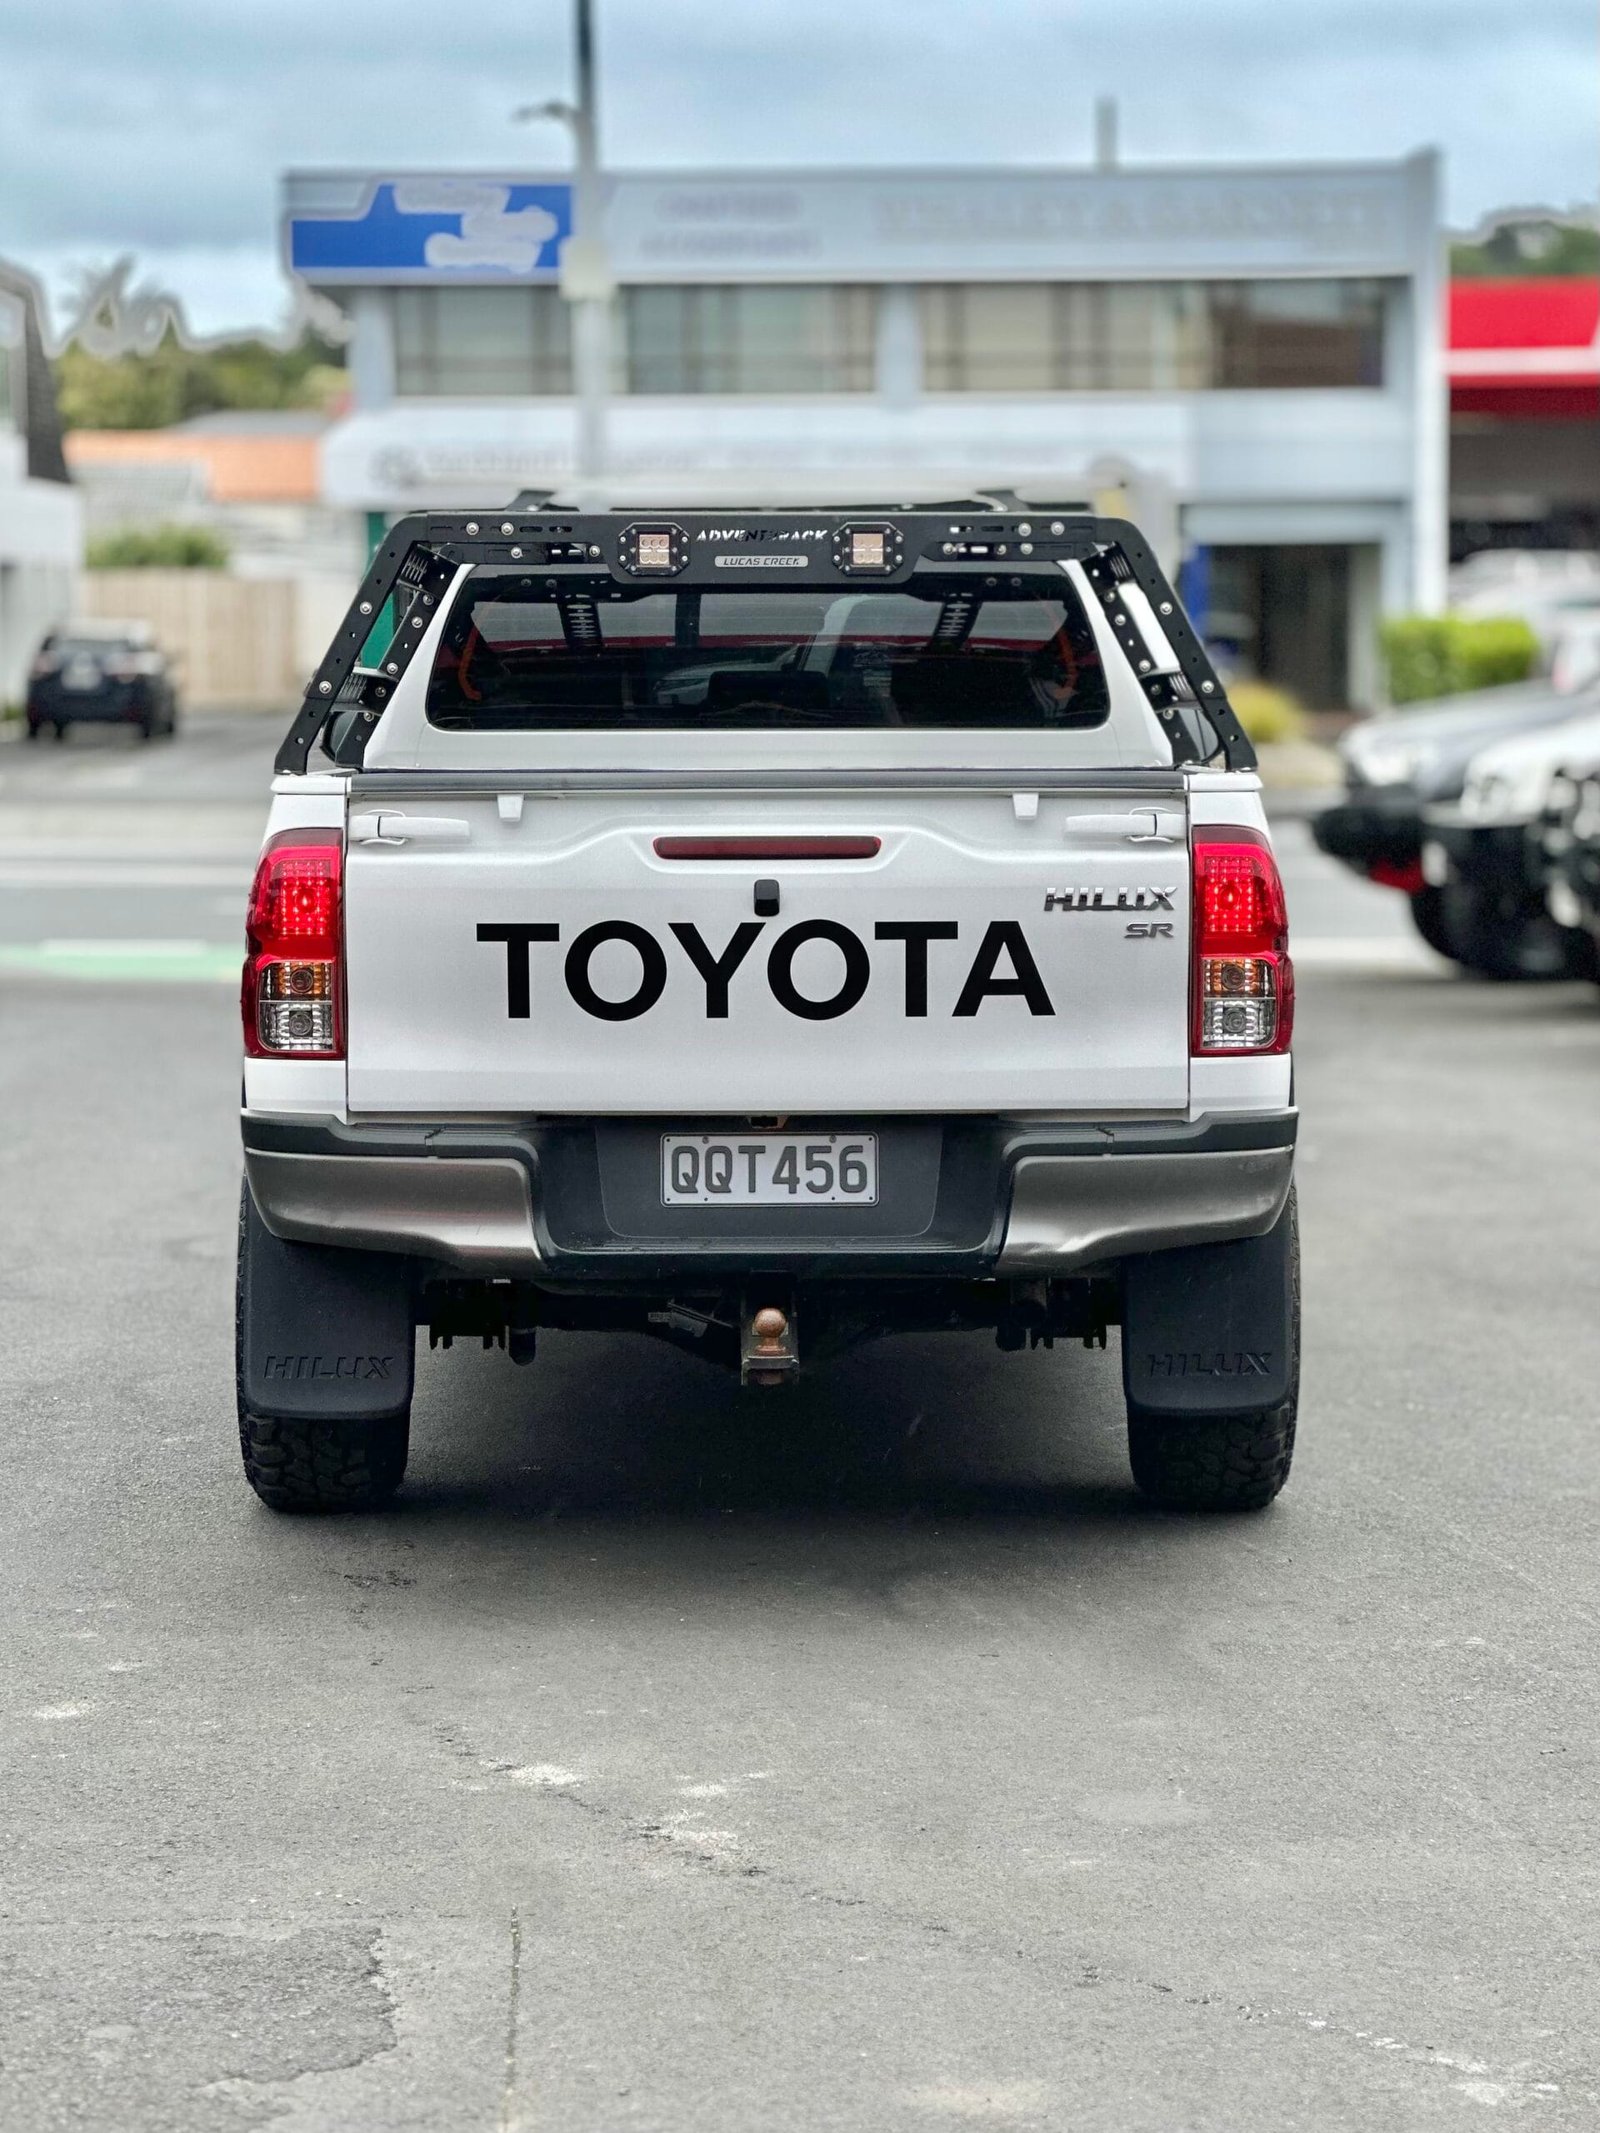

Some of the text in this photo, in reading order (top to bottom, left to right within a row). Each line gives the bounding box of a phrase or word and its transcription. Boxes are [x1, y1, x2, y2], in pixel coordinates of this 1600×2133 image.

[723, 557, 800, 566] LUCAS CREEK
[1044, 887, 1177, 912] HILUX
[1124, 921, 1174, 939] SR
[476, 919, 1056, 1021] TOYOTA
[671, 1145, 868, 1194] QQT456
[264, 1356, 394, 1379] HILUX
[1148, 1353, 1272, 1376] HILUX
